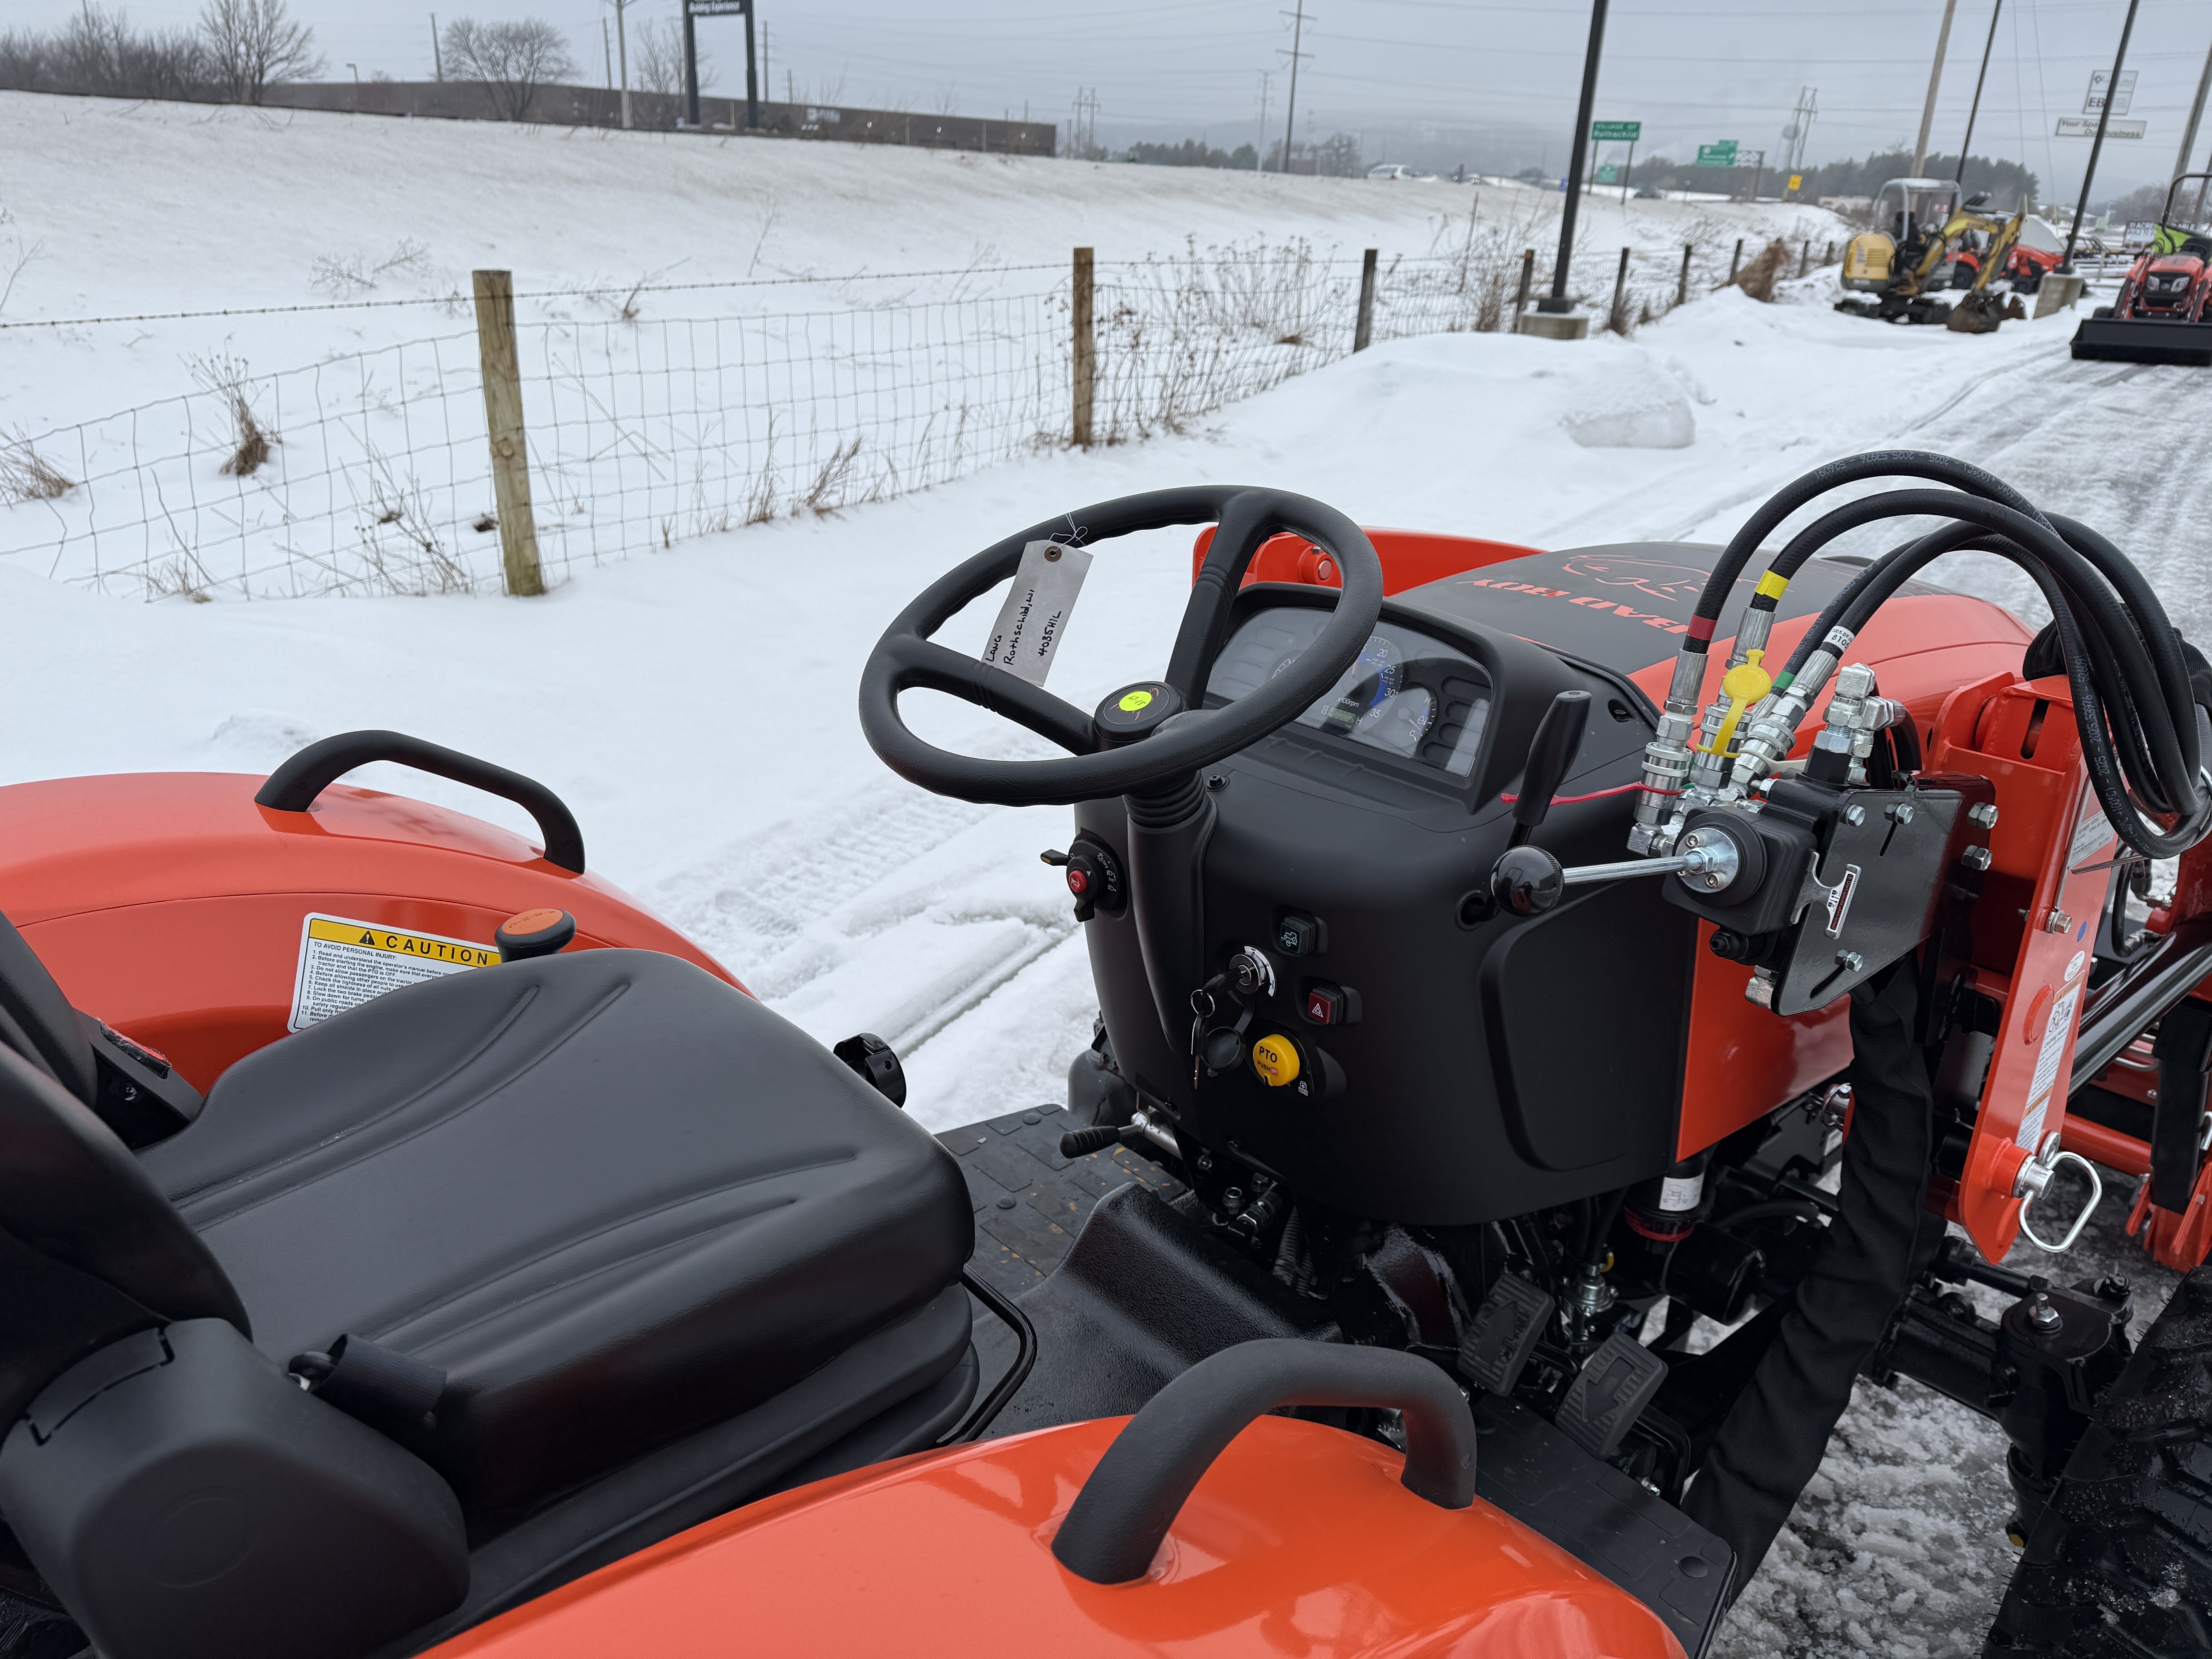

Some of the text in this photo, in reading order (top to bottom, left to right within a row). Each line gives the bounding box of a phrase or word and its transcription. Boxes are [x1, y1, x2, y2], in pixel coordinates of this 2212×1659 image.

[1929, 454, 1950, 465] 2025
[1815, 461, 1846, 478] 526091
[1456, 579, 1689, 634] BAD BOY
[1377, 648, 1388, 658] 20
[1384, 665, 1396, 674] 25
[1384, 688, 1396, 697] 30
[1370, 708, 1381, 718] 35
[1355, 716, 1363, 725] H
[2094, 756, 2110, 776] 2025
[343, 946, 374, 957] PERSONAL
[376, 952, 397, 960] INJURY:
[386, 936, 488, 965] CAUTION
[344, 955, 373, 963] understand
[1259, 1046, 1277, 1063] PTO
[1258, 1060, 1270, 1072] PUSH
